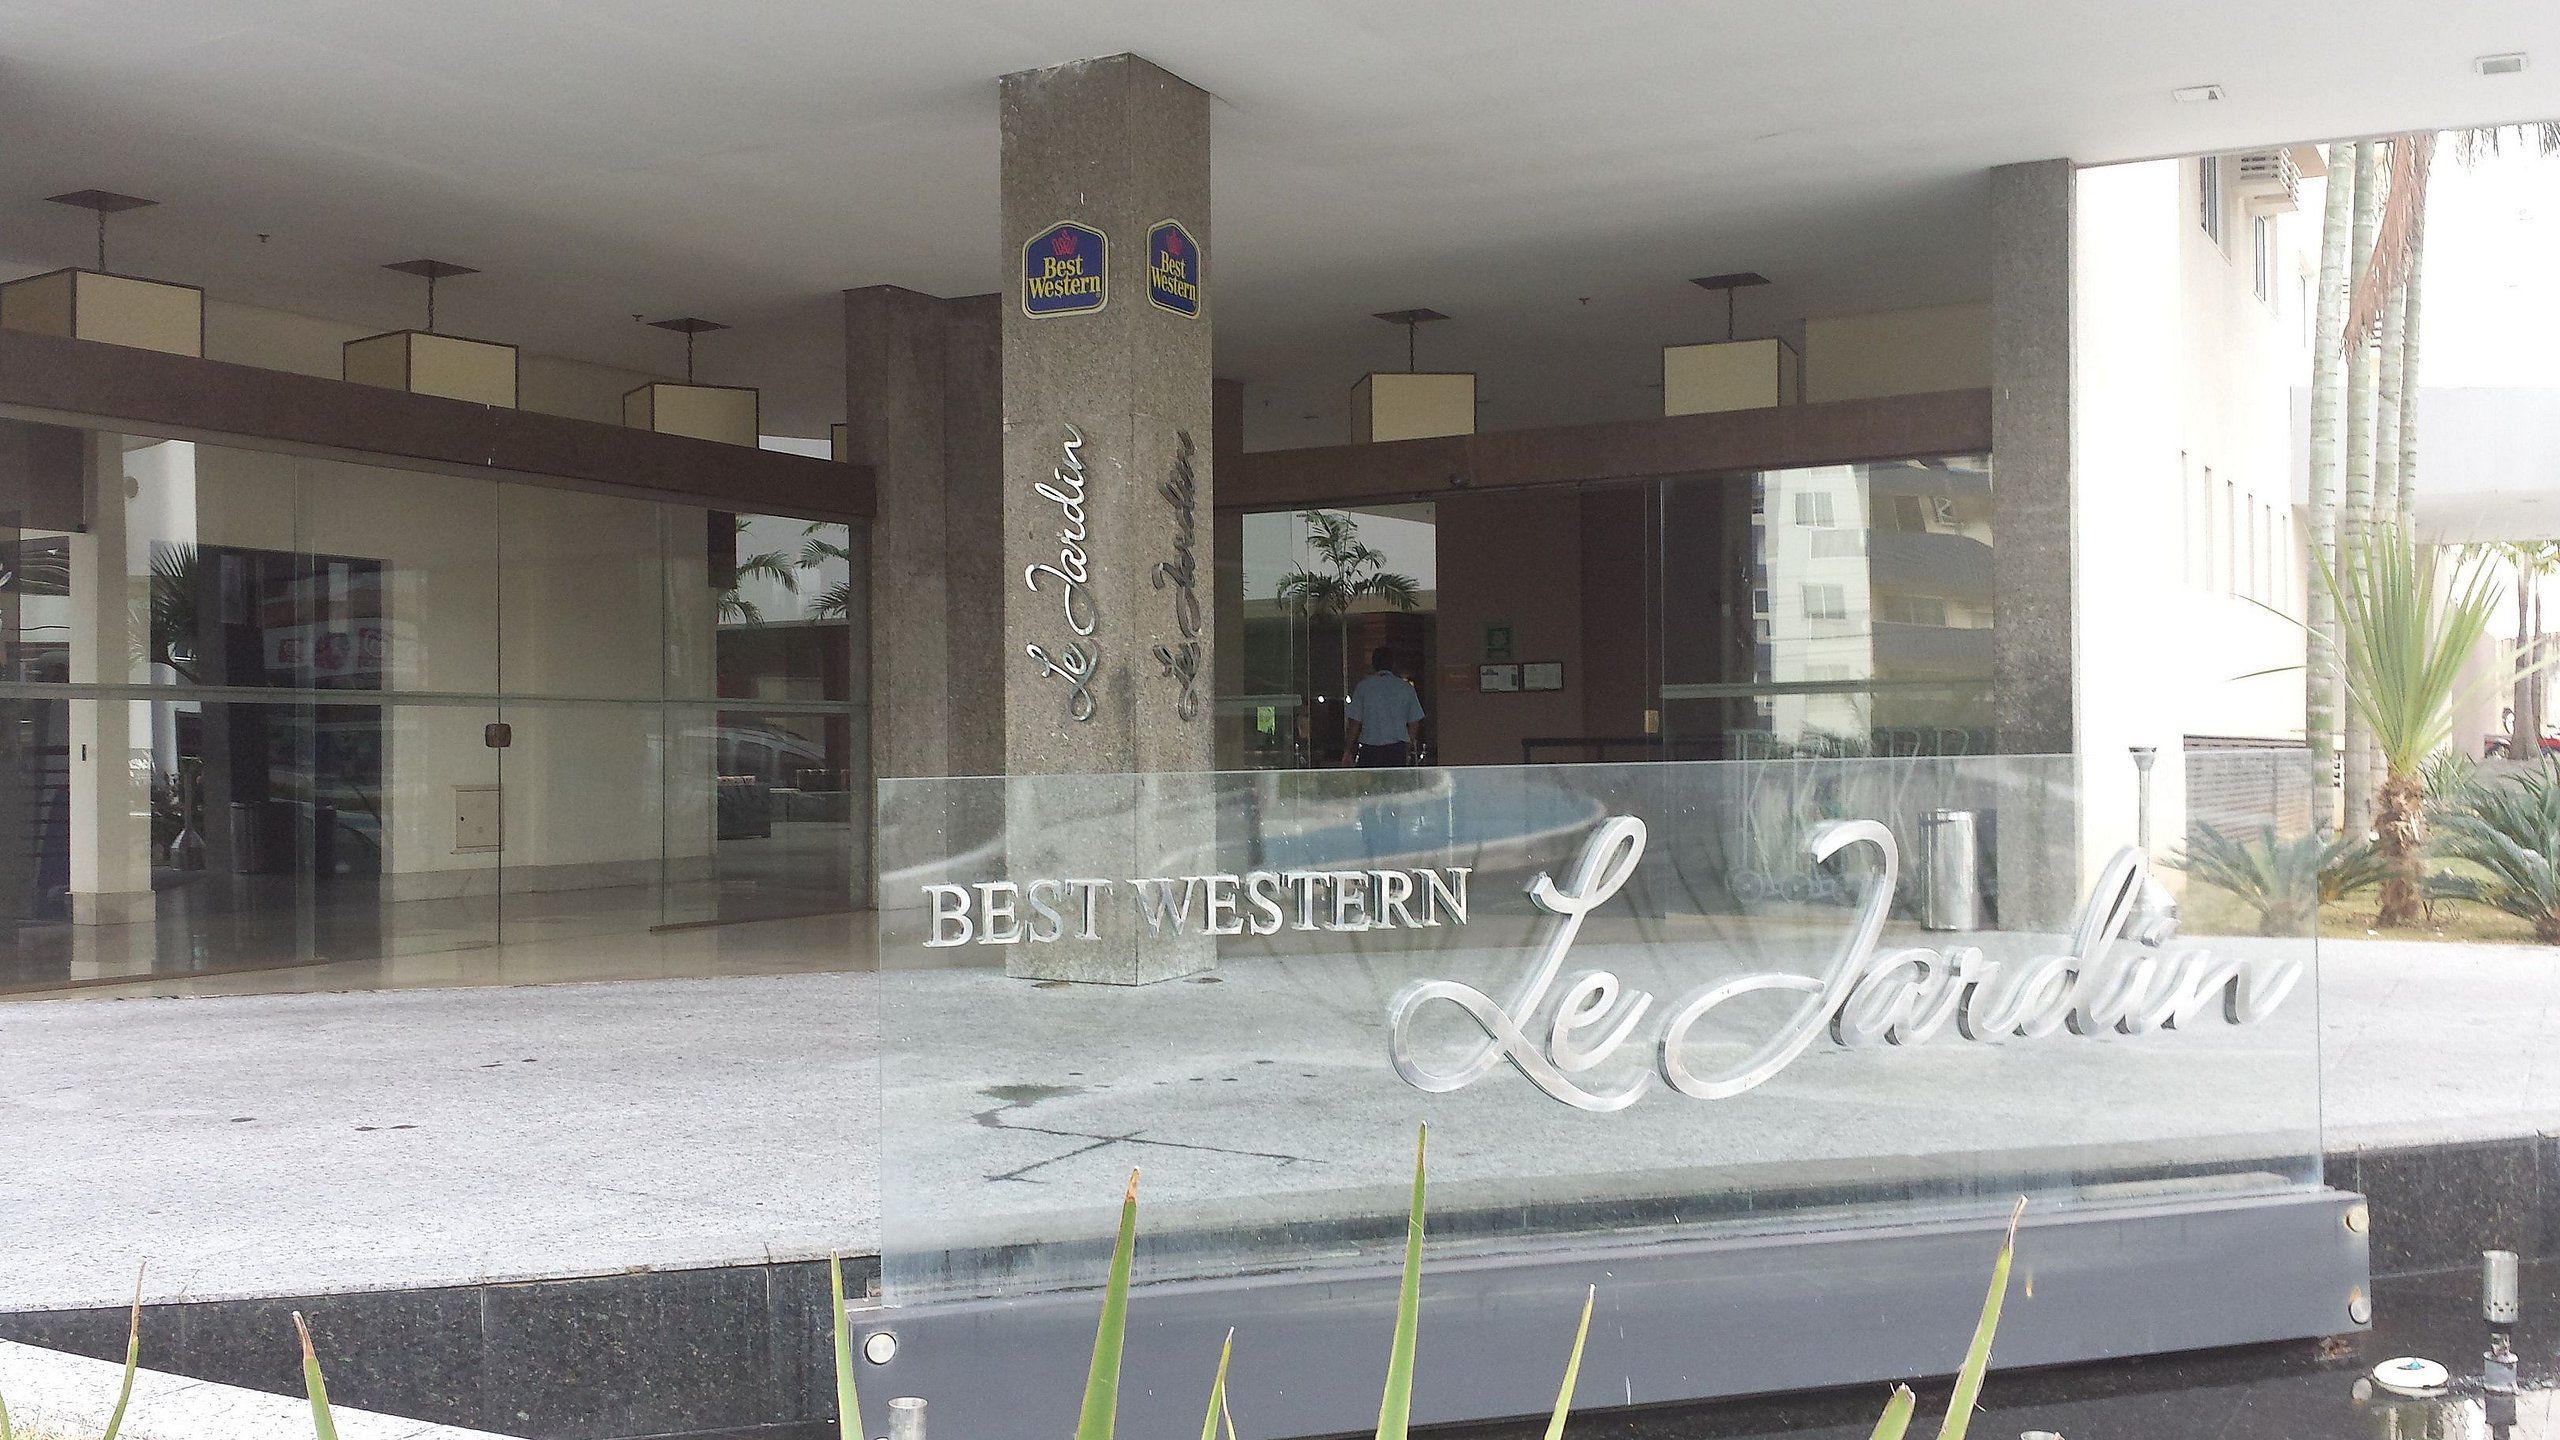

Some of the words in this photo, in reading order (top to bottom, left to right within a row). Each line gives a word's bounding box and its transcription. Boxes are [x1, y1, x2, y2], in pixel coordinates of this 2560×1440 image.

[1029, 274, 1102, 299] Western
[1044, 254, 1084, 279] Best
[1151, 265, 1198, 302] Western
[1160, 250, 1187, 280] Best
[1024, 422, 1096, 637] Jardin
[1026, 640, 1097, 722] Le
[921, 879, 1114, 949] BEST
[1128, 867, 1474, 937] WESTERN
[1388, 814, 1655, 1112] Le
[1656, 818, 2303, 1100] Jardin
